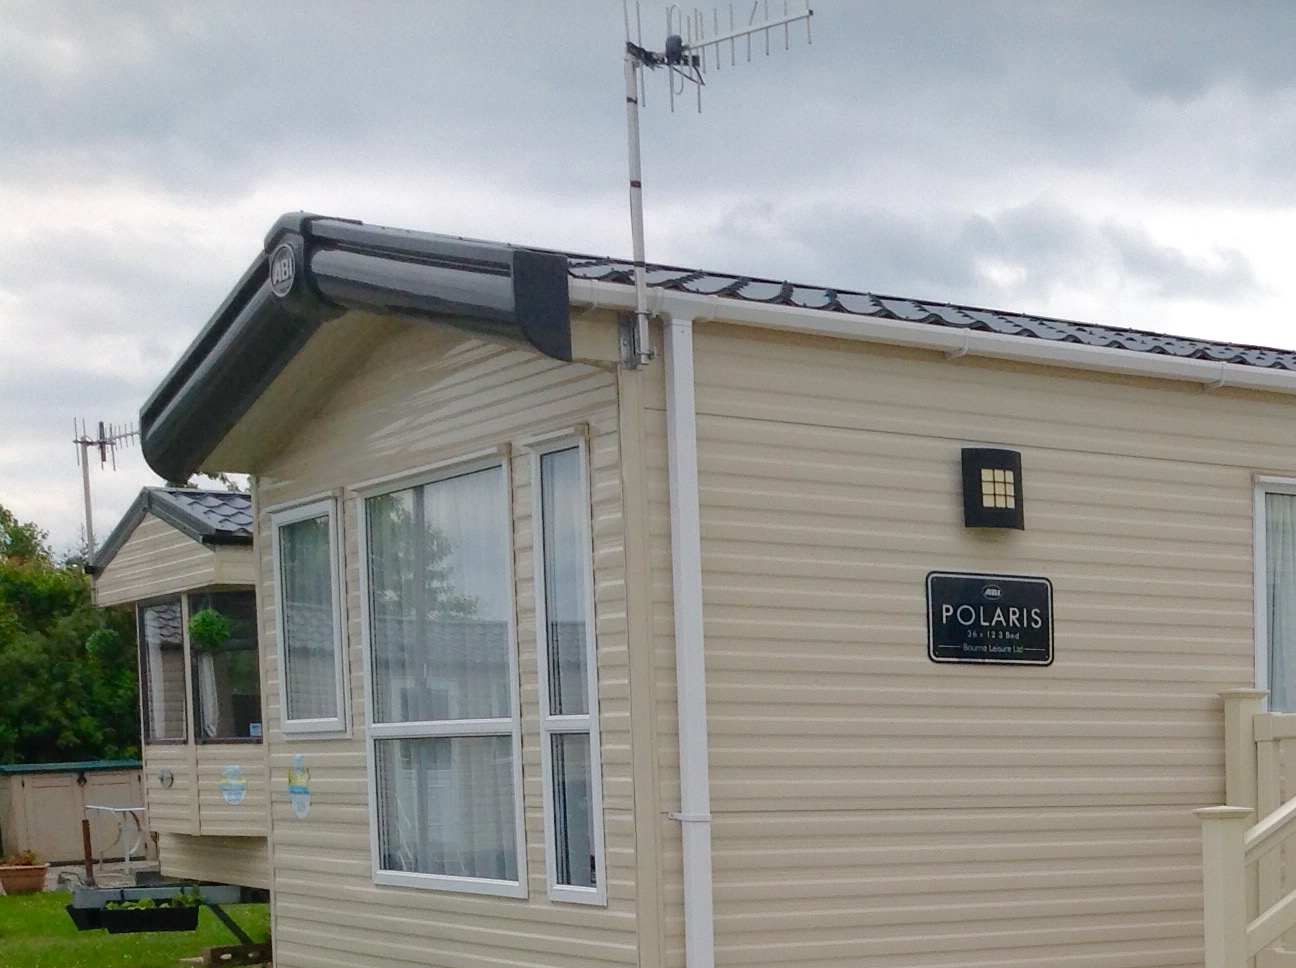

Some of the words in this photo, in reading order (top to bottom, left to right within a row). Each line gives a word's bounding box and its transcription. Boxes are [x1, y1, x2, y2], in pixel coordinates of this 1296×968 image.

[273, 257, 293, 285] ABI
[942, 604, 1042, 629] POLARIS
[986, 631, 996, 639] 12
[1005, 631, 1020, 640] Bed
[962, 643, 987, 652] Bourne
[1013, 646, 1024, 654] Ltd
